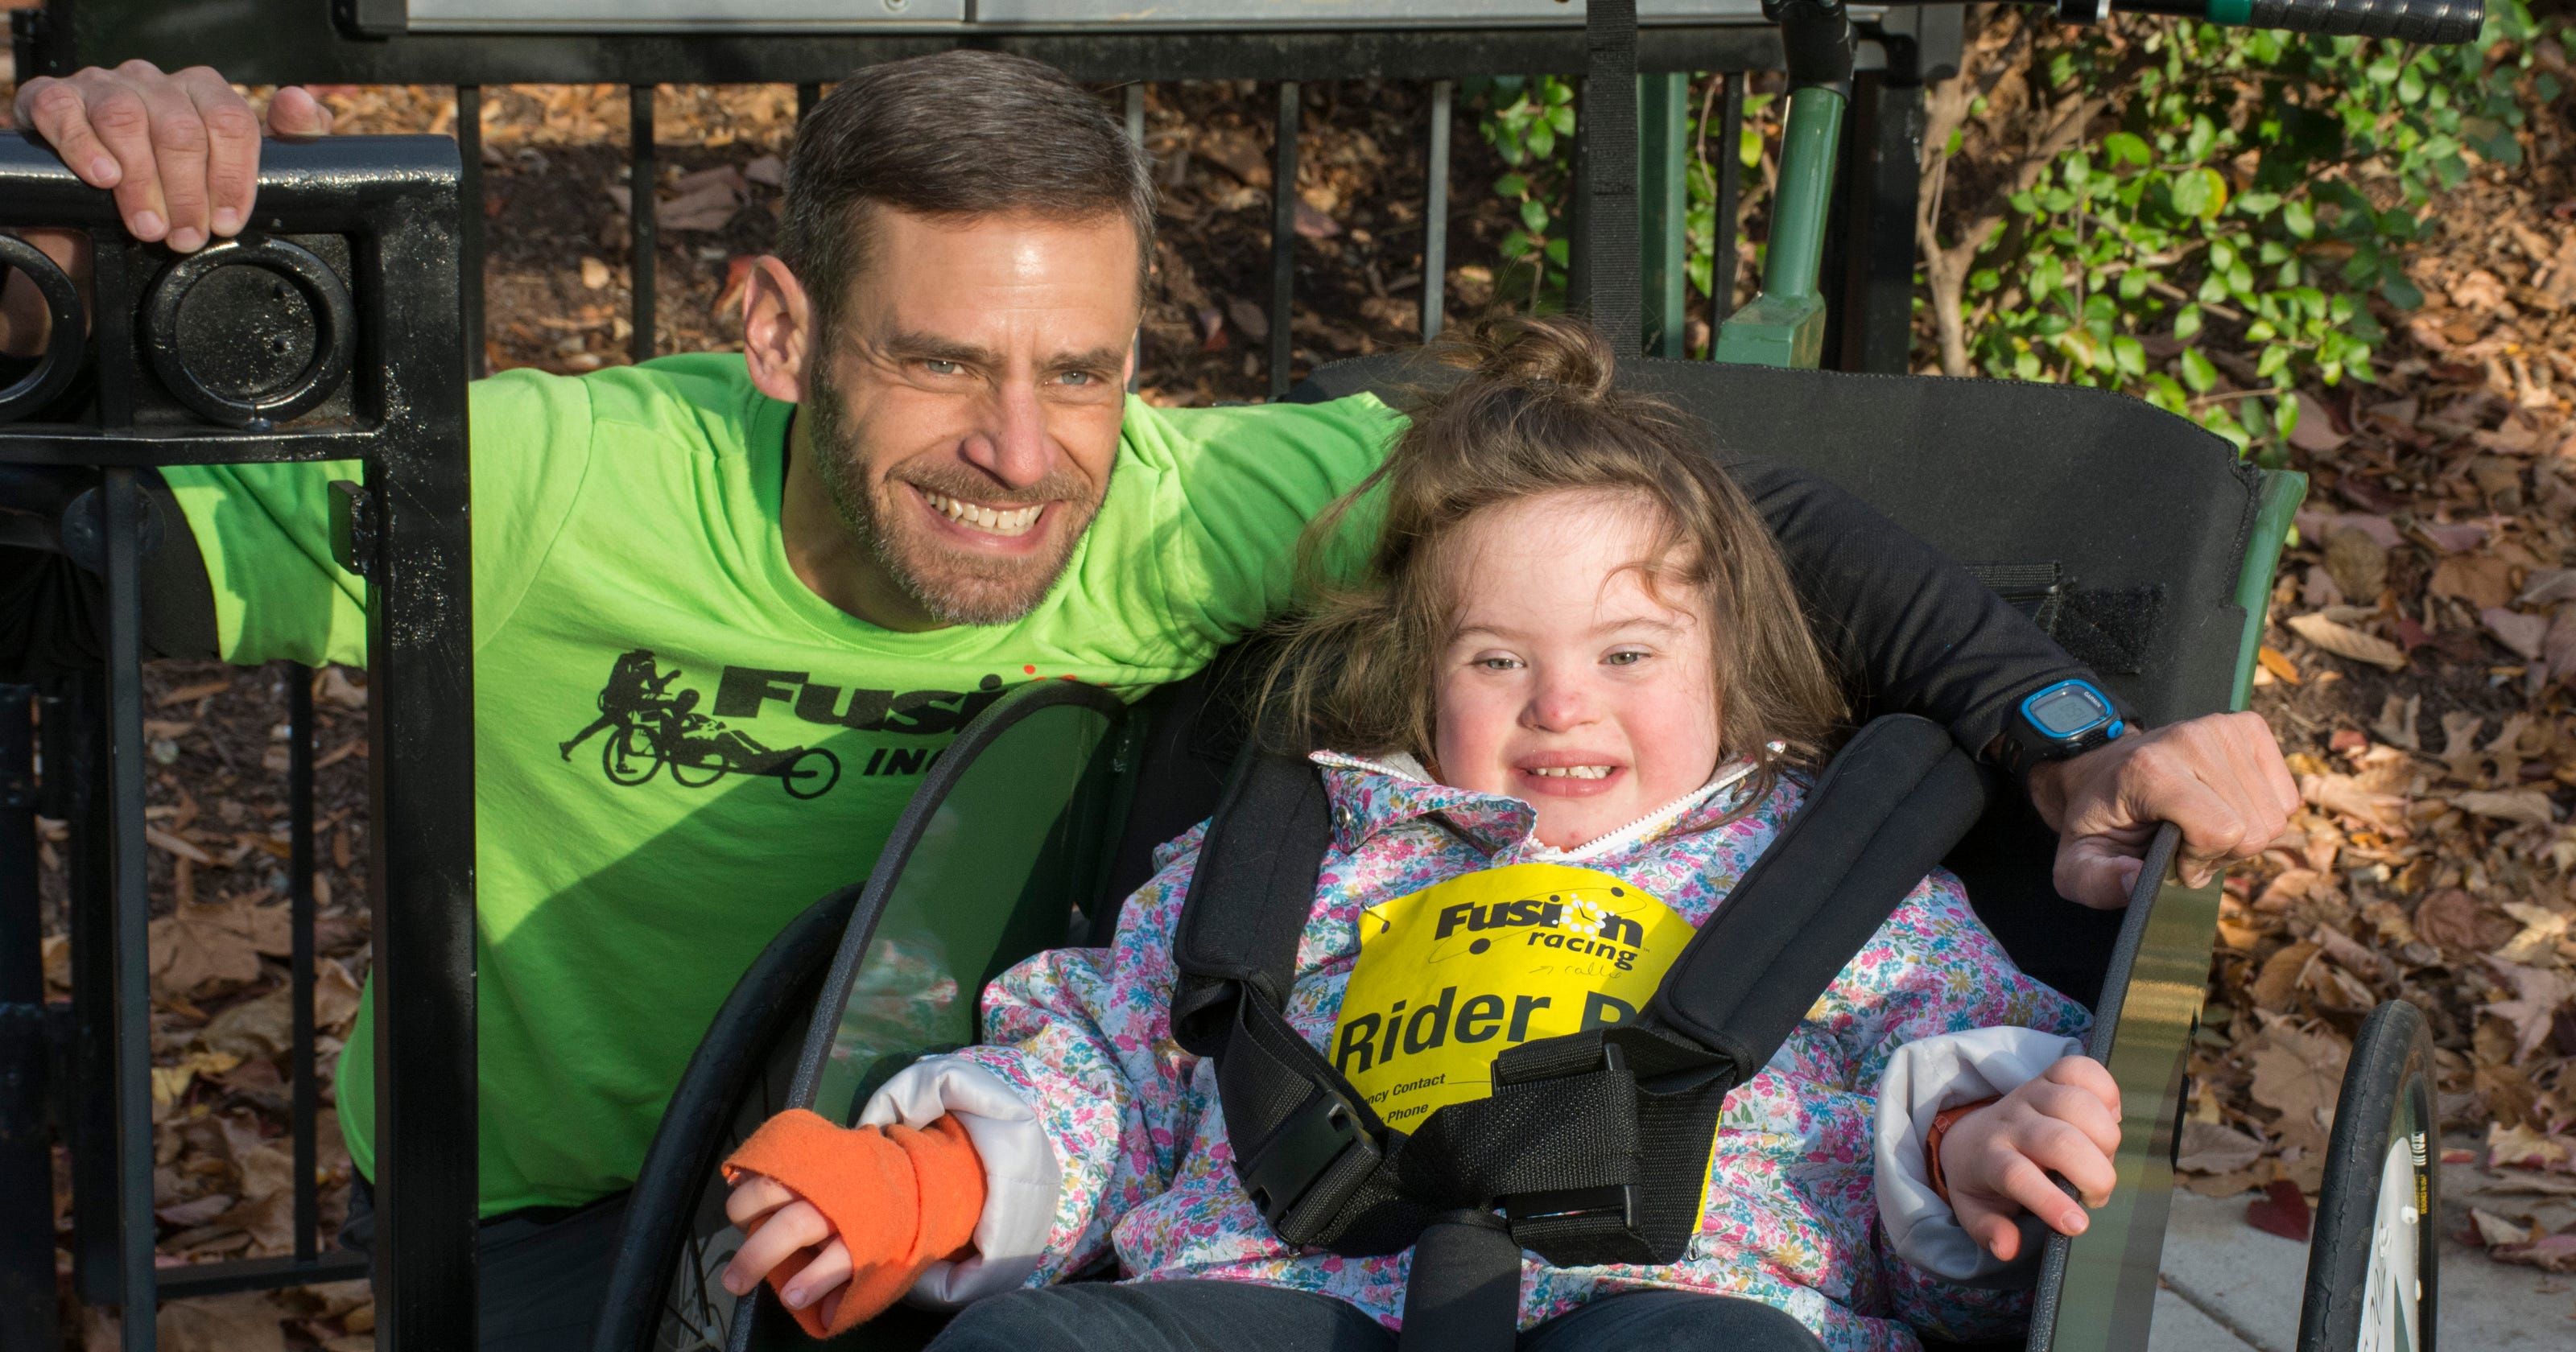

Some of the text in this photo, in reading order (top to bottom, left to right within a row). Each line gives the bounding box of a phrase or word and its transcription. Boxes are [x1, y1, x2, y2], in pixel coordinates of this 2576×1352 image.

[712, 665, 1009, 736] Fusi
[863, 748, 945, 776] IN
[1435, 893, 1644, 948] Fusion
[1527, 931, 1638, 971] racing
[1335, 986, 1552, 1076] Rider
[1364, 1073, 1447, 1106] ncy Contact
[1387, 1103, 1430, 1123] Phone
